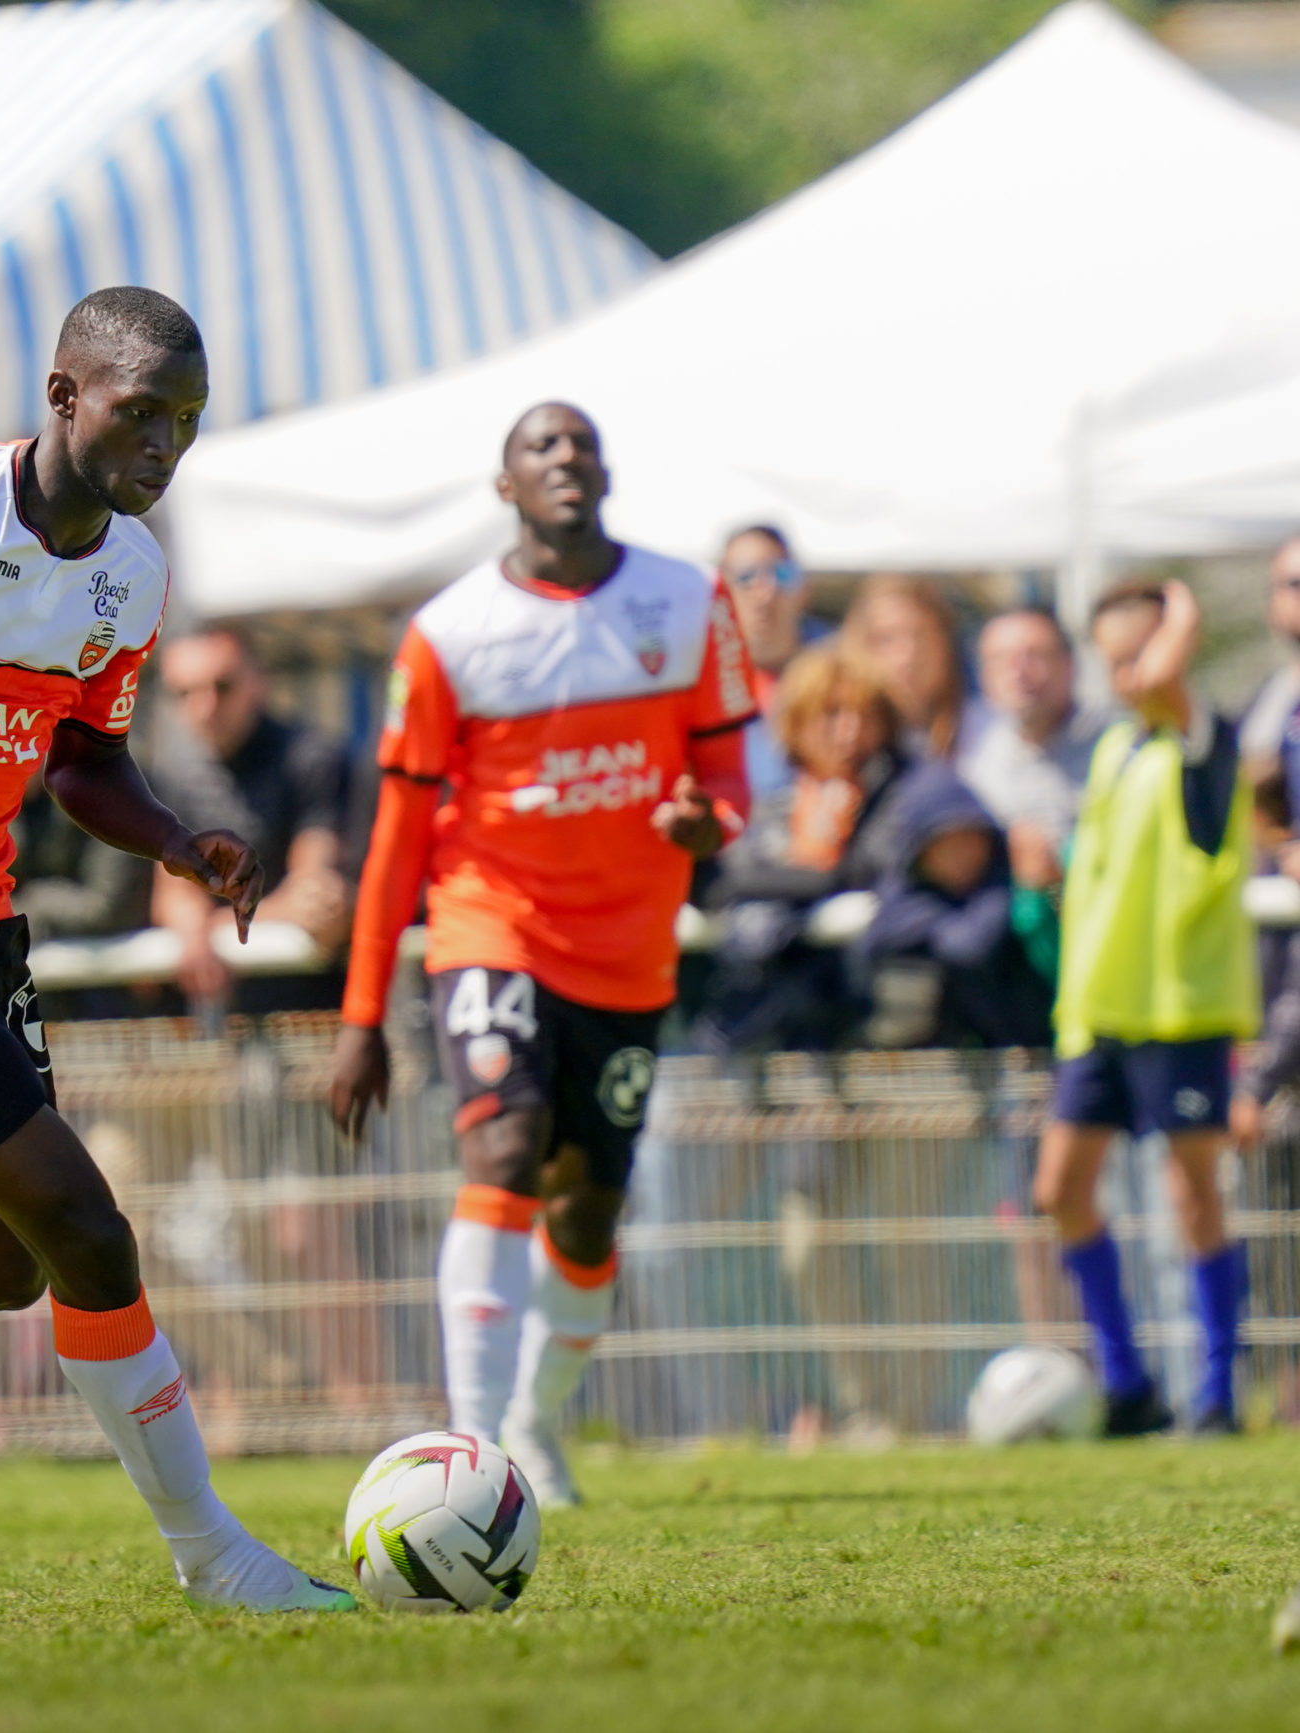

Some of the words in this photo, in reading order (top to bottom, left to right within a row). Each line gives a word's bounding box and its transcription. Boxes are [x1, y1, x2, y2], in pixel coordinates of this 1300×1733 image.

[537, 739, 647, 786] JEAN
[446, 967, 539, 1040] 44
[425, 1537, 454, 1573] KIPSTA
